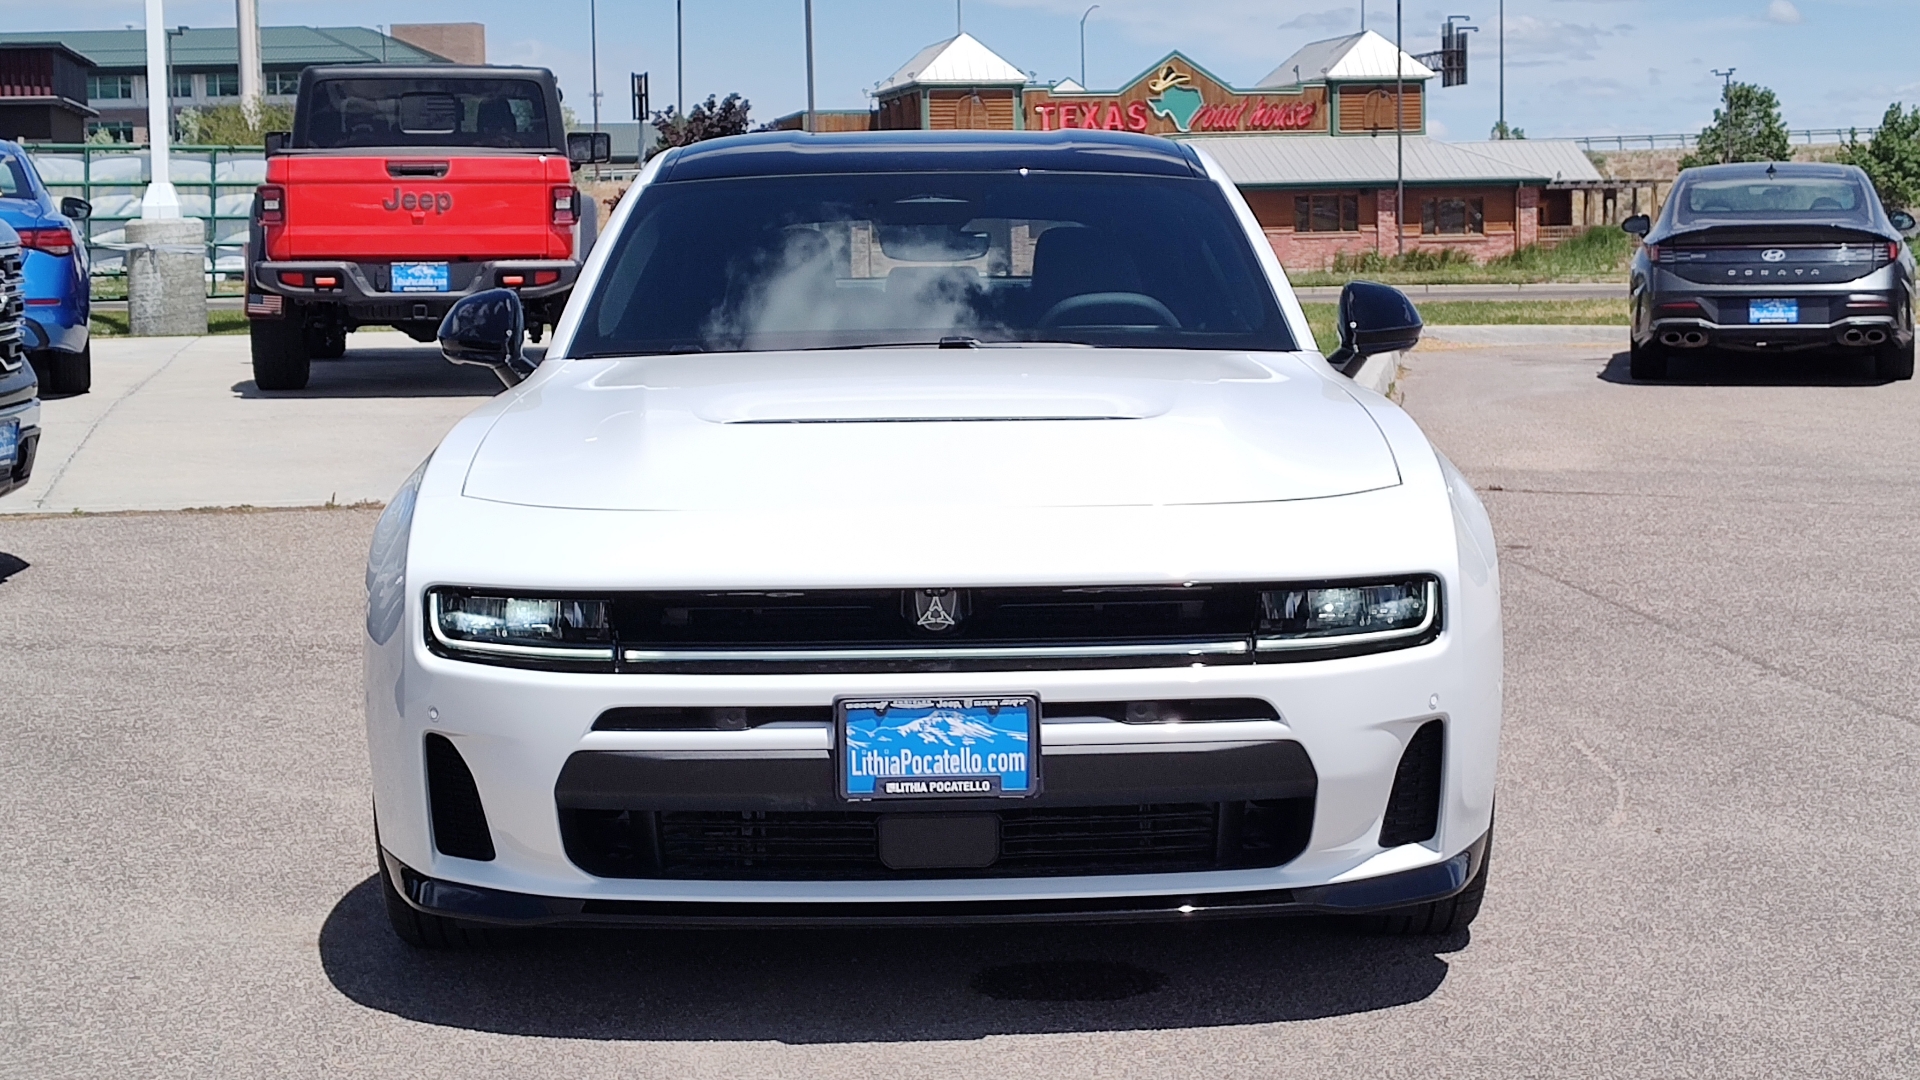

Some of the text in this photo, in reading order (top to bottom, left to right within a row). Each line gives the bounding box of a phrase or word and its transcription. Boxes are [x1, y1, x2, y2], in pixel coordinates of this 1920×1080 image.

[1035, 96, 1316, 131] TEXAS road house
[382, 187, 453, 216] Jeep
[851, 747, 1026, 776] LithiaPocatello.com
[895, 780, 990, 793] LITHIA POCATELLO
